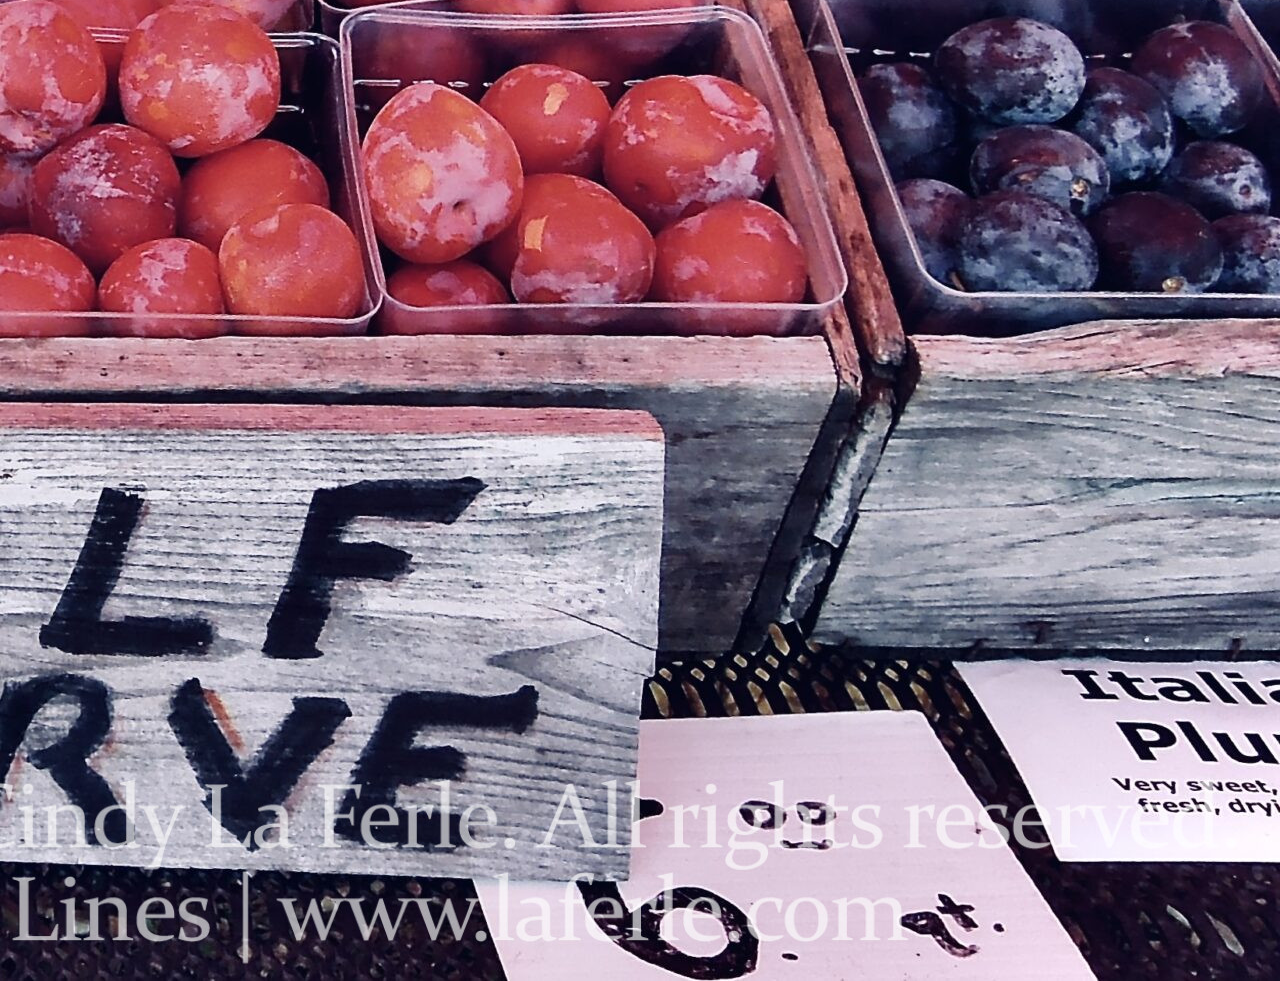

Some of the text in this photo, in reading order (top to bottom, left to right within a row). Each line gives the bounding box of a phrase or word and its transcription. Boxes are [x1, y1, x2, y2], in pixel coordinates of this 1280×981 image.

[1116, 720, 1280, 764] Plu
[1112, 777, 1277, 796] Very sweet,
[1138, 798, 1220, 815] fresh,
